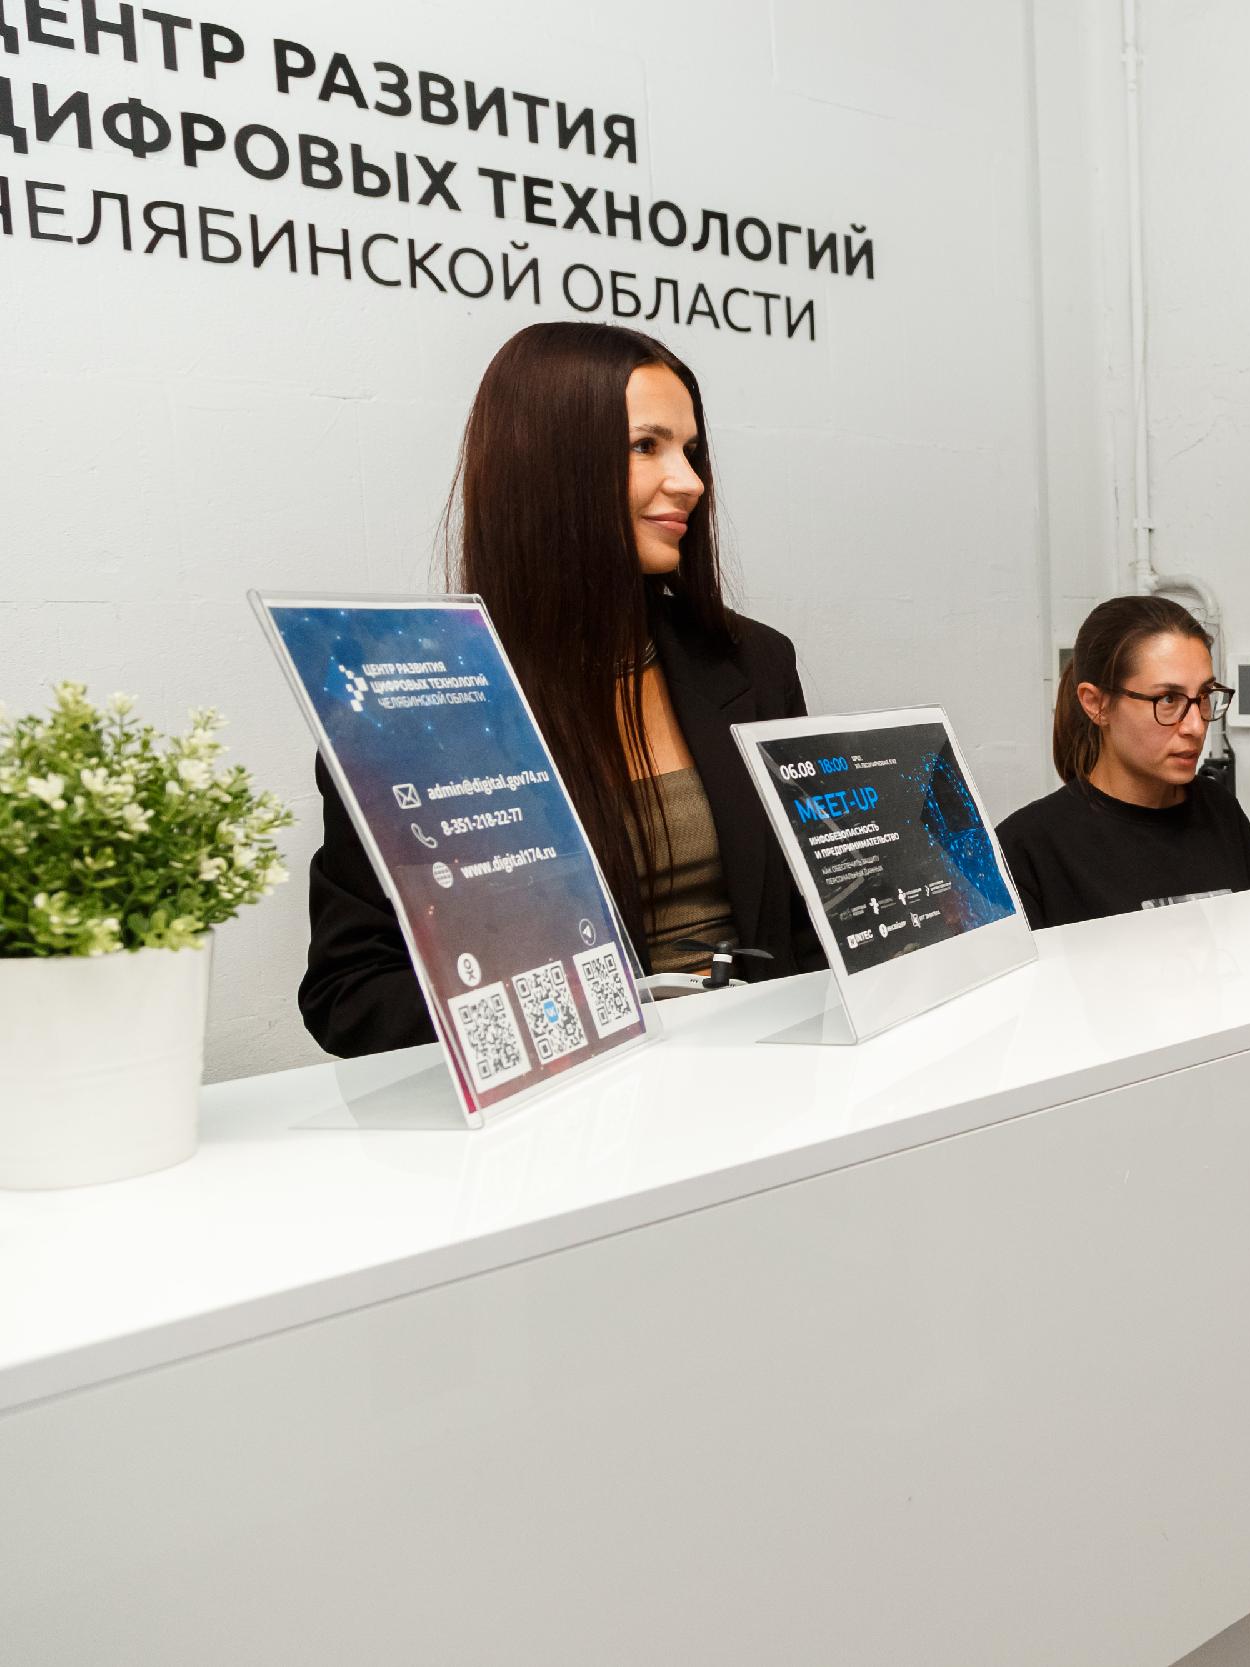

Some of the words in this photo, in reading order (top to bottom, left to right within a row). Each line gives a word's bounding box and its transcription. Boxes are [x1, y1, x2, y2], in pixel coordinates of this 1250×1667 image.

[273, 38, 638, 164] РАЗВИТИЯ
[478, 166, 876, 280] ТЕХНОЛОГИЙ
[562, 263, 816, 341] ОБЛАСТИ
[362, 662, 396, 678] ЦЕНТР
[395, 661, 447, 675] РАЗВИТИЯ
[370, 679, 429, 694] ЦИФРОВЫХ
[427, 673, 489, 689] ТЕХНОЛОГИЙ
[378, 691, 447, 709] ЧЕЛЯБИНСКОЙ
[446, 690, 487, 705] ОБЛАСТИ
[780, 760, 816, 781] 06.08
[817, 755, 849, 775] 18:00
[427, 770, 549, 800] admin@digital.gov74.ru
[793, 785, 879, 824] MEET-UP
[440, 807, 524, 837] 8-351-218-22-77
[808, 823, 880, 847] ИНФОБЕЗОПАСНОСТЬ
[460, 846, 557, 879] www.digital174.ru
[813, 850, 822, 859] И
